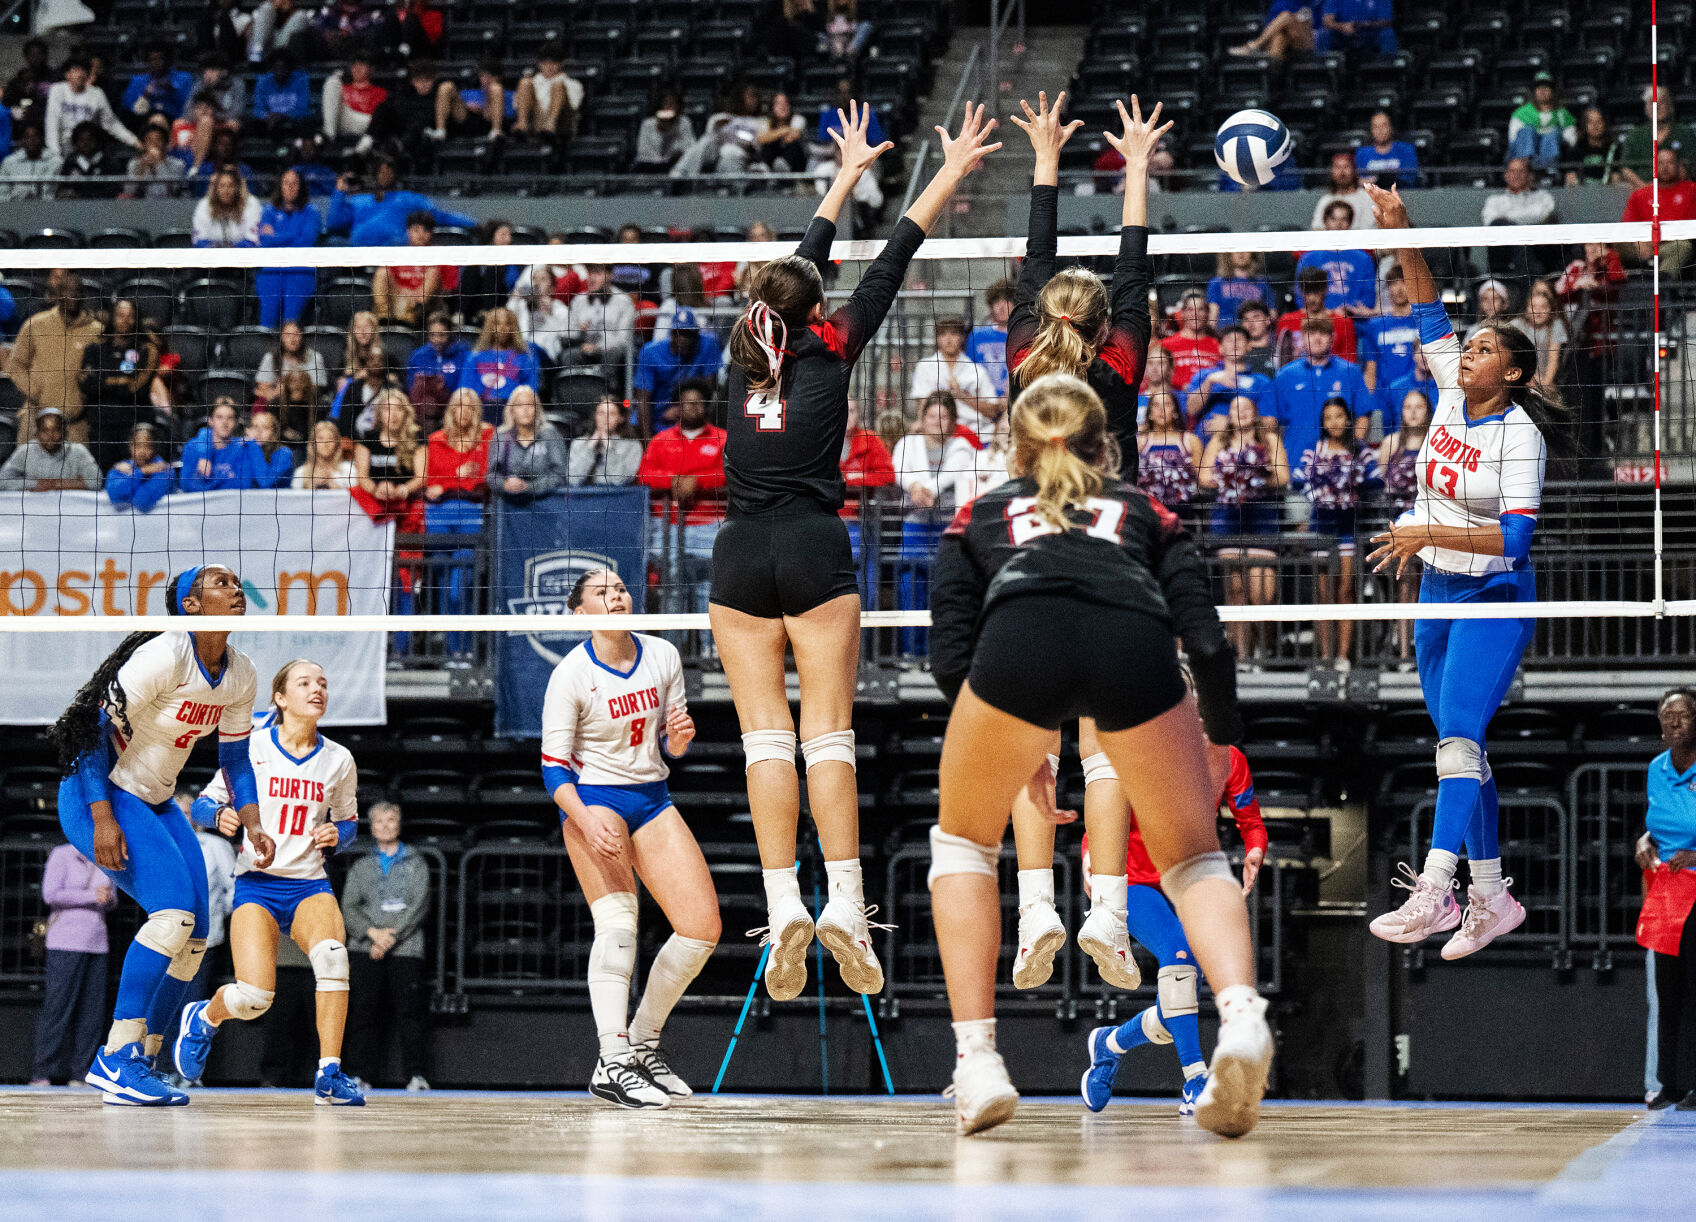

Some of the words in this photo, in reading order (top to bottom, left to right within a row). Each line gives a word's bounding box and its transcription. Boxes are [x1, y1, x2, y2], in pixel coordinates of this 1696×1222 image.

[744, 375, 787, 432] 4
[1430, 425, 1482, 473] CURTIS
[1426, 459, 1459, 499] 13
[1003, 496, 1128, 547] 27
[0, 557, 349, 616] pstrm
[608, 687, 660, 719] CURTIS
[630, 717, 646, 747] 8
[268, 777, 325, 803] CURTIS
[278, 803, 309, 836] 10
